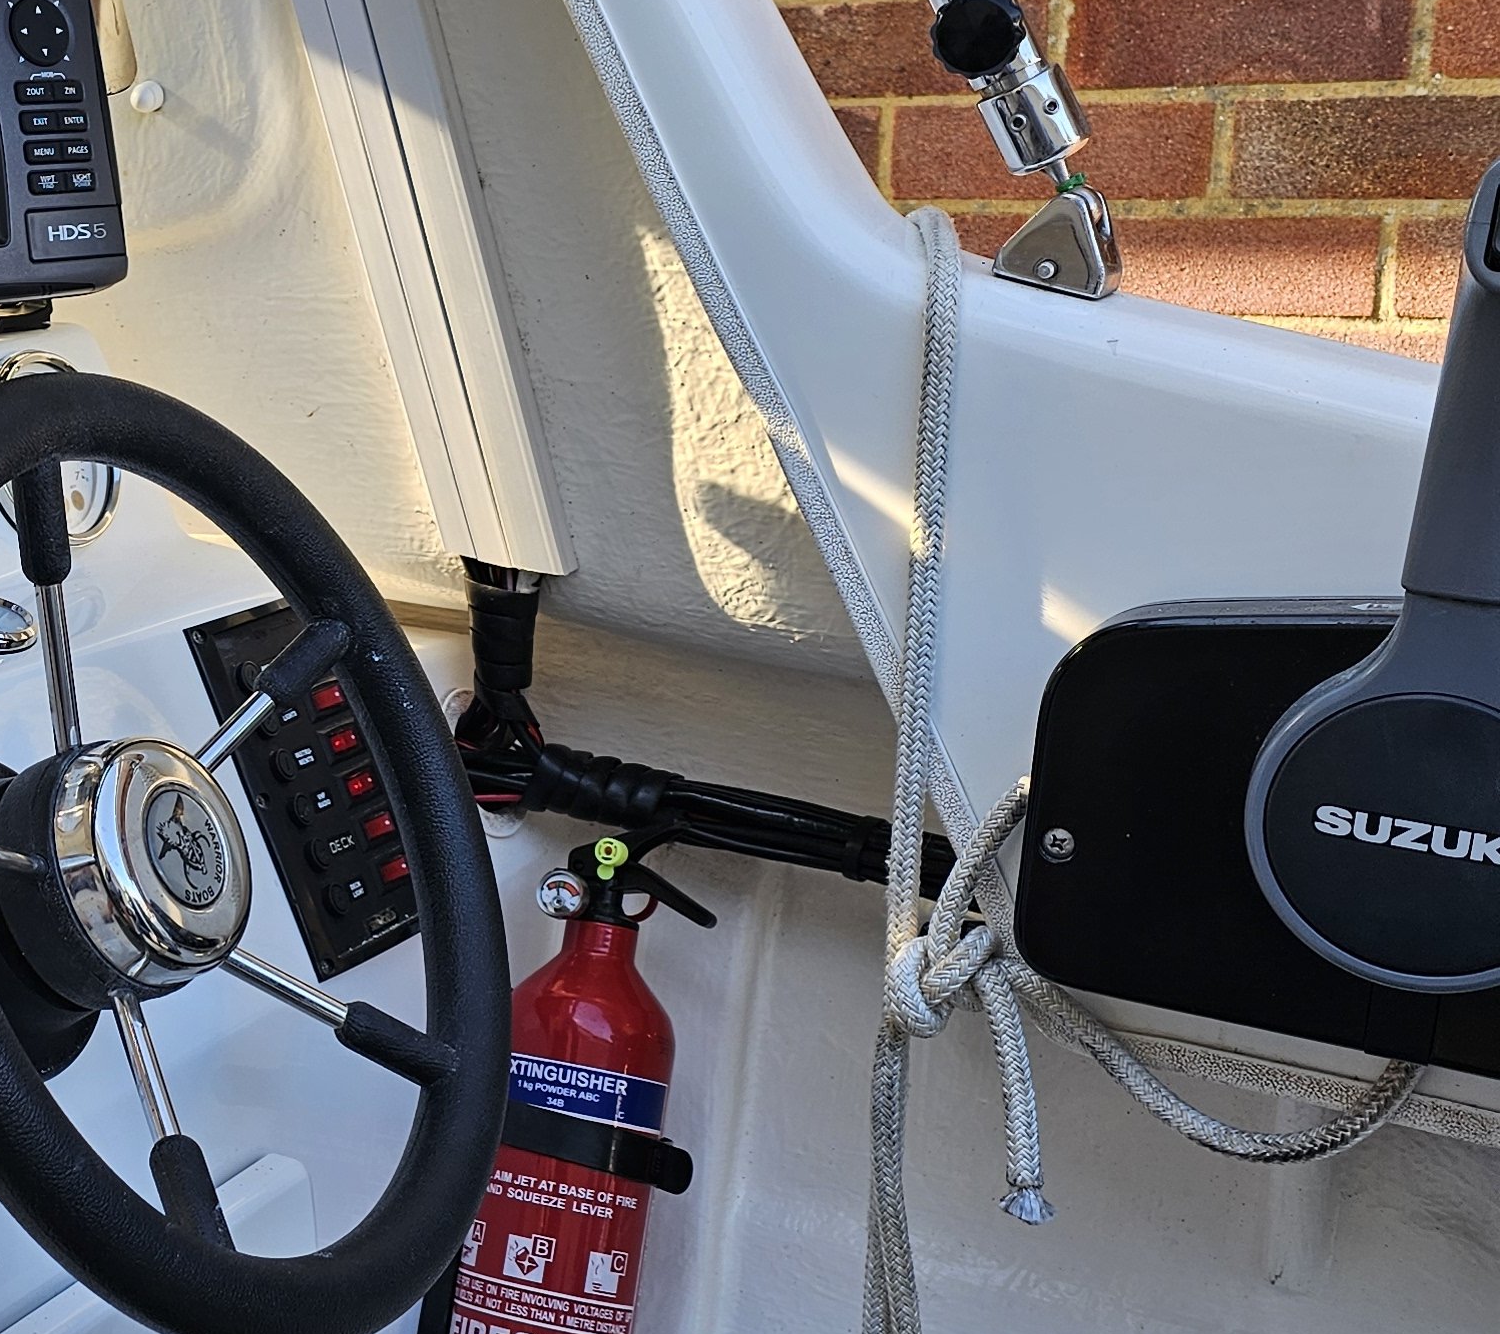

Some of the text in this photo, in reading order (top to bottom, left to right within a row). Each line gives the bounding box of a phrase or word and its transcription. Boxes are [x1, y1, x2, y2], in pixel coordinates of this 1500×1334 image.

[26, 87, 45, 96] ZOUT
[64, 87, 76, 95] ZIN
[32, 117, 48, 126] EXIT
[64, 116, 85, 125] ENTER
[34, 147, 55, 156] MENU
[67, 146, 89, 155] PAGES
[40, 175, 55, 183] WPT
[72, 173, 92, 182] LIGHT
[1313, 804, 1500, 866] SUZUK
[204, 818, 223, 884] WARRIOR
[329, 835, 355, 854] DECK
[185, 885, 215, 903] BOATS
[510, 1059, 628, 1096] XTINGUISHER
[523, 1081, 533, 1091] kg
[534, 1082, 577, 1098] POWDER
[578, 1092, 600, 1103] ABC
[546, 1097, 565, 1108] 34B
[514, 1174, 537, 1188] JET
[538, 1181, 557, 1192] AT
[558, 1183, 595, 1201] BASE
[597, 1191, 614, 1204] OF
[615, 1195, 638, 1209] FIRE
[506, 1186, 567, 1210] SQUEEZE
[572, 1201, 613, 1219] LEVER
[474, 1226, 482, 1239] A
[536, 1240, 550, 1257] B
[612, 1255, 624, 1271] C
[470, 1279, 484, 1292] USE
[486, 1283, 498, 1295] ON
[500, 1287, 520, 1303] FIRE
[521, 1292, 570, 1313] INVOLVING
[573, 1303, 614, 1321] VOLTAGES
[615, 1311, 625, 1322] OF
[474, 1292, 483, 1305] AT
[485, 1296, 502, 1310] NOT
[504, 1300, 529, 1317] LESS
[530, 1307, 556, 1323] THAN
[566, 1315, 596, 1330] METRE
